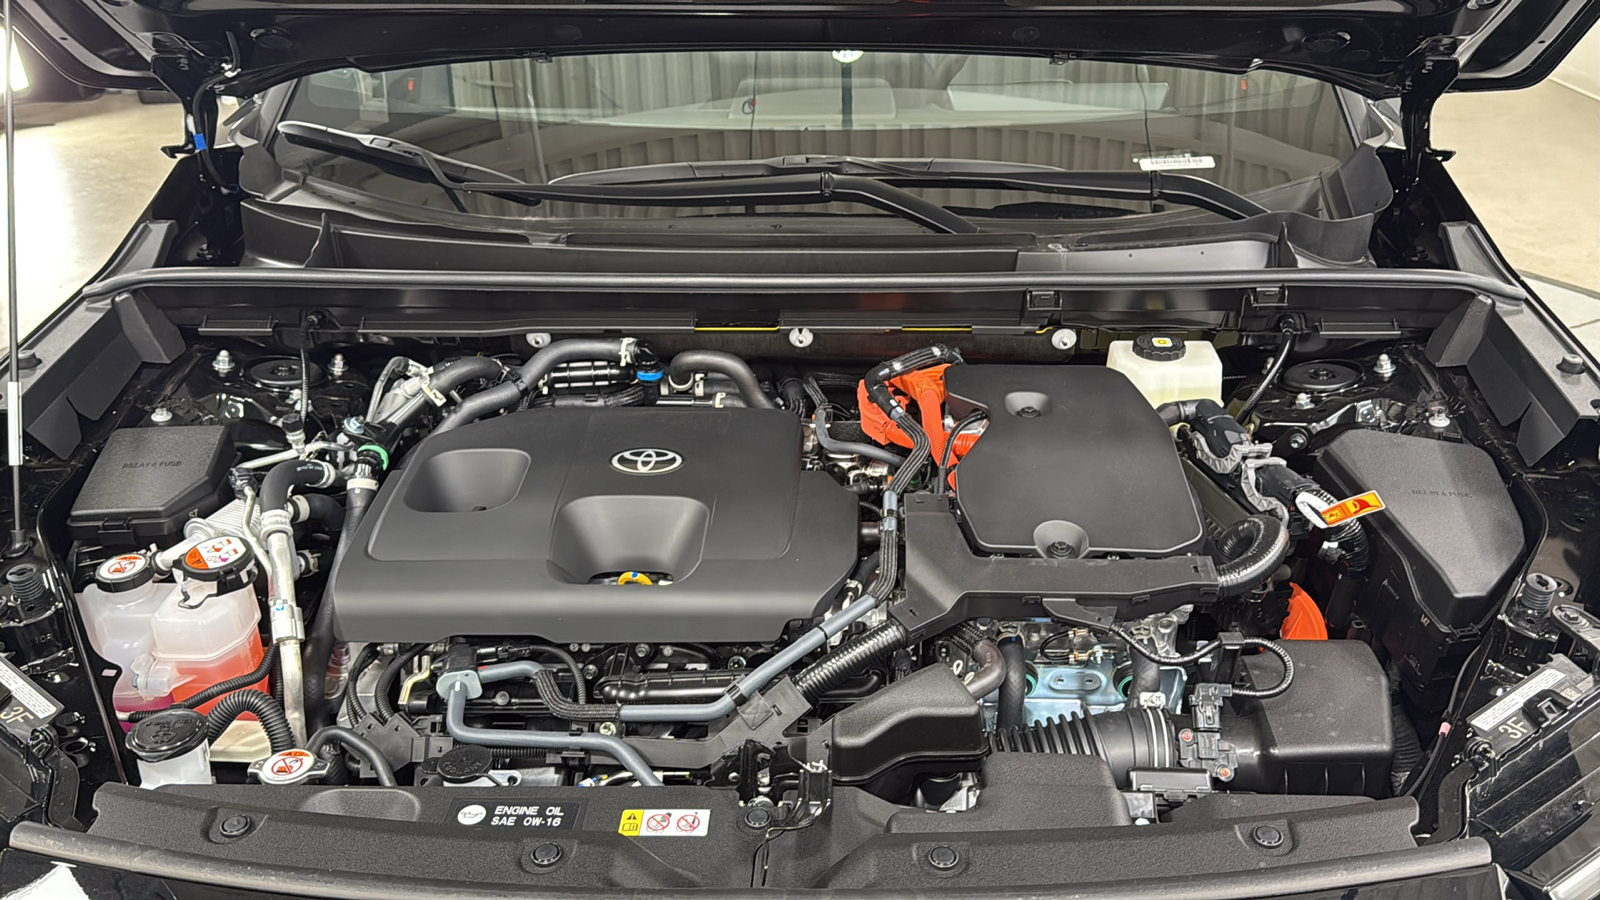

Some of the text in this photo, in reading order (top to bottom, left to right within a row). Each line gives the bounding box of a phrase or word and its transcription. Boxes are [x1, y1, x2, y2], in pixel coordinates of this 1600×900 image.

[34, 633, 54, 644] 10R
[0, 706, 34, 724] 3F
[1498, 717, 1528, 739] 3F
[494, 806, 564, 816] ENGINE OIL
[491, 816, 562, 827] SAE 0W-16
